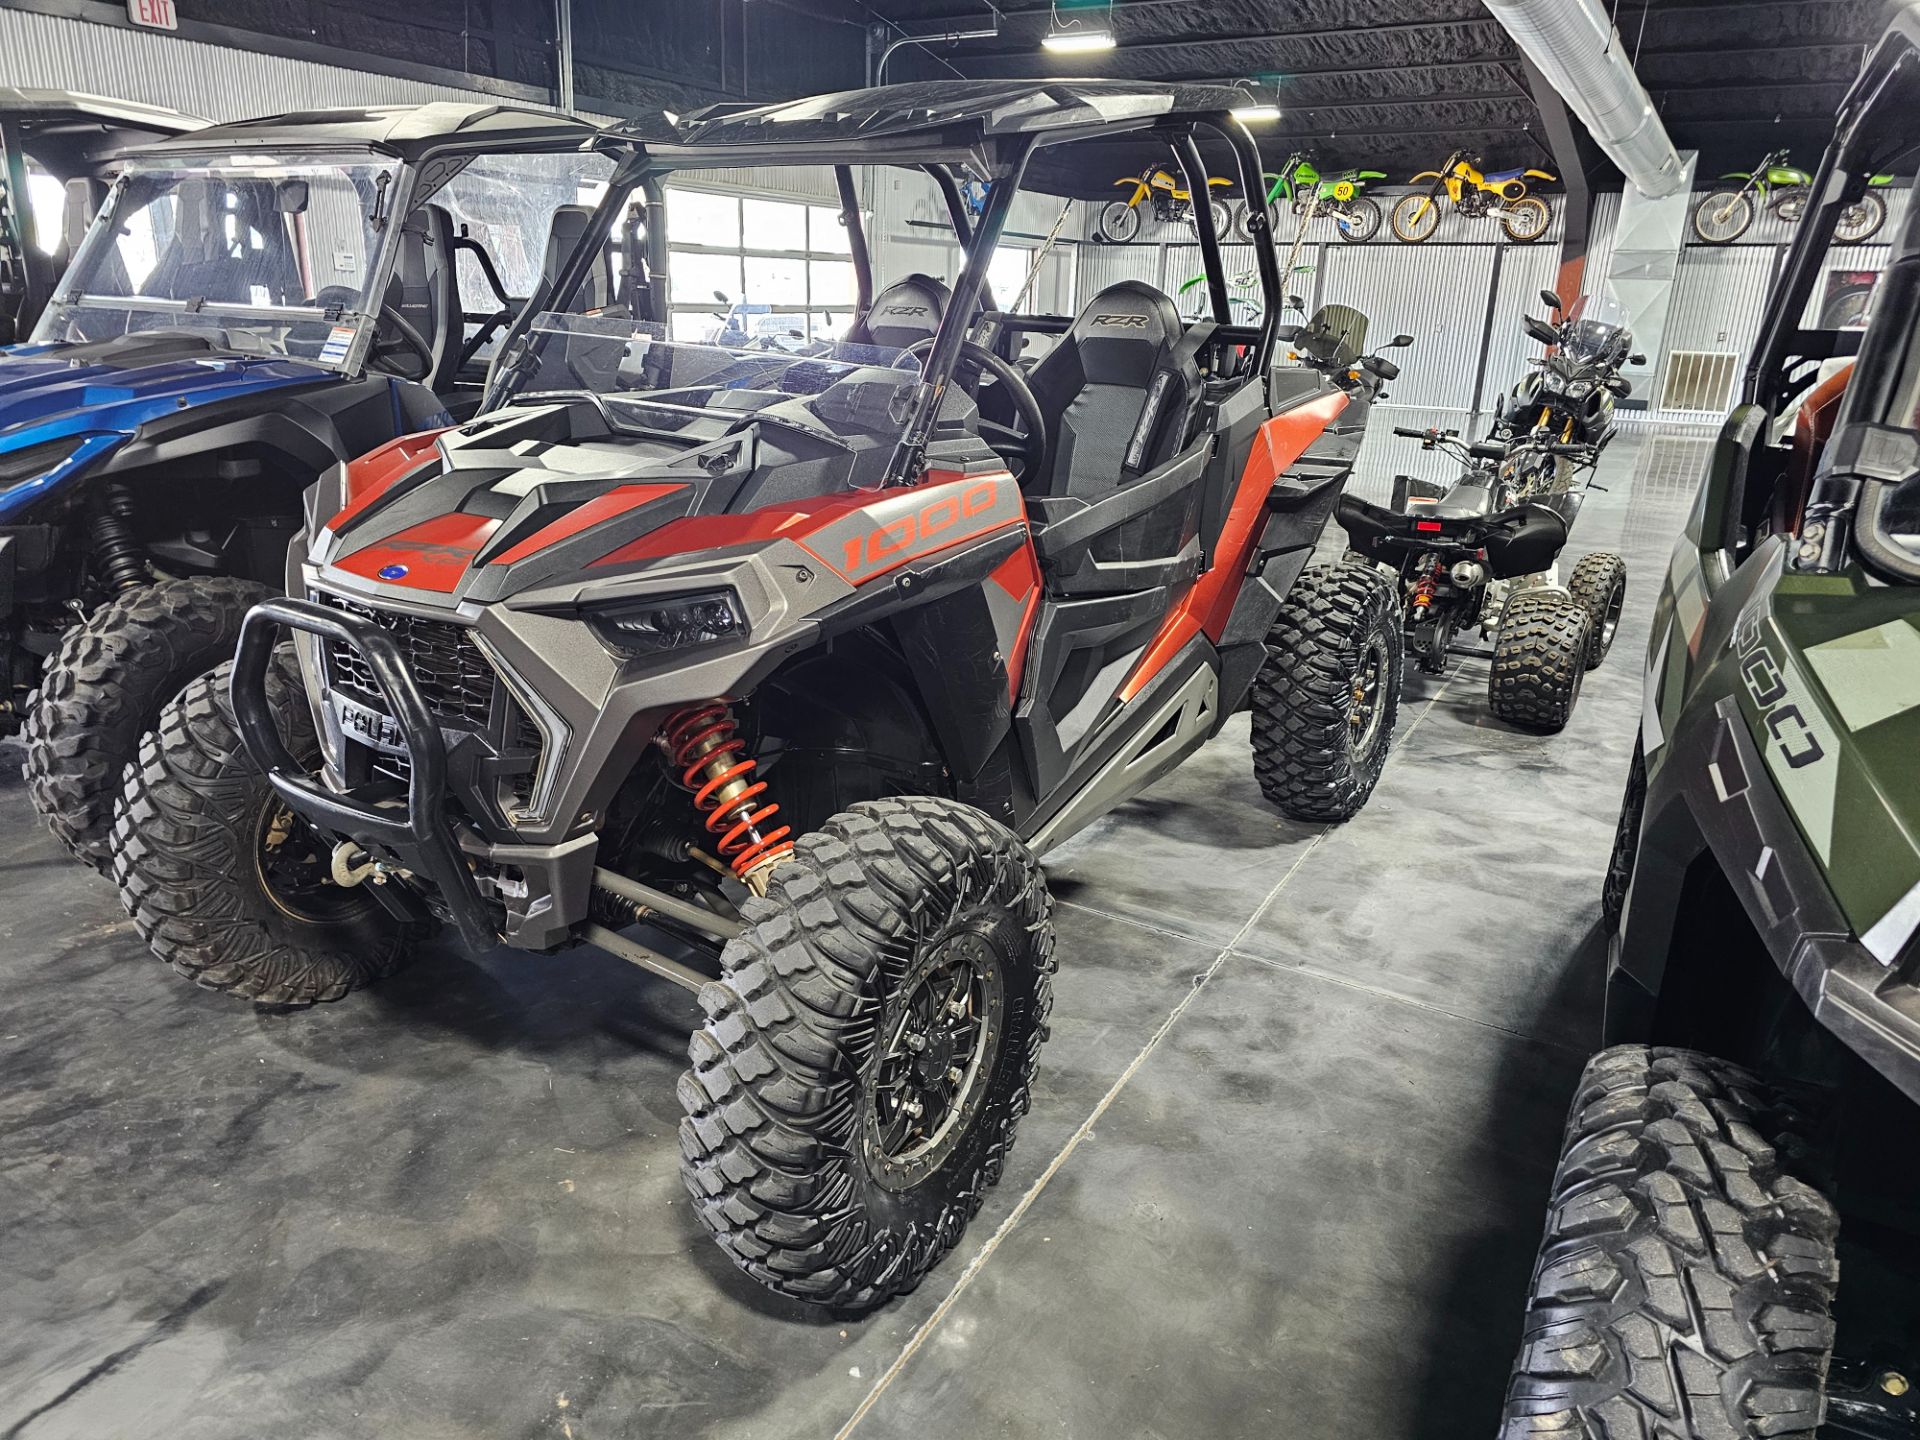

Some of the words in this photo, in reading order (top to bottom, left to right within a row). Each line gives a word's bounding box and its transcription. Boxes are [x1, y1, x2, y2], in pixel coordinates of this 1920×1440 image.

[138, 0, 170, 26] EXIT
[1337, 186, 1349, 196] 50
[880, 305, 929, 317] RZR
[1088, 313, 1150, 329] RZR
[843, 479, 998, 574] 1000
